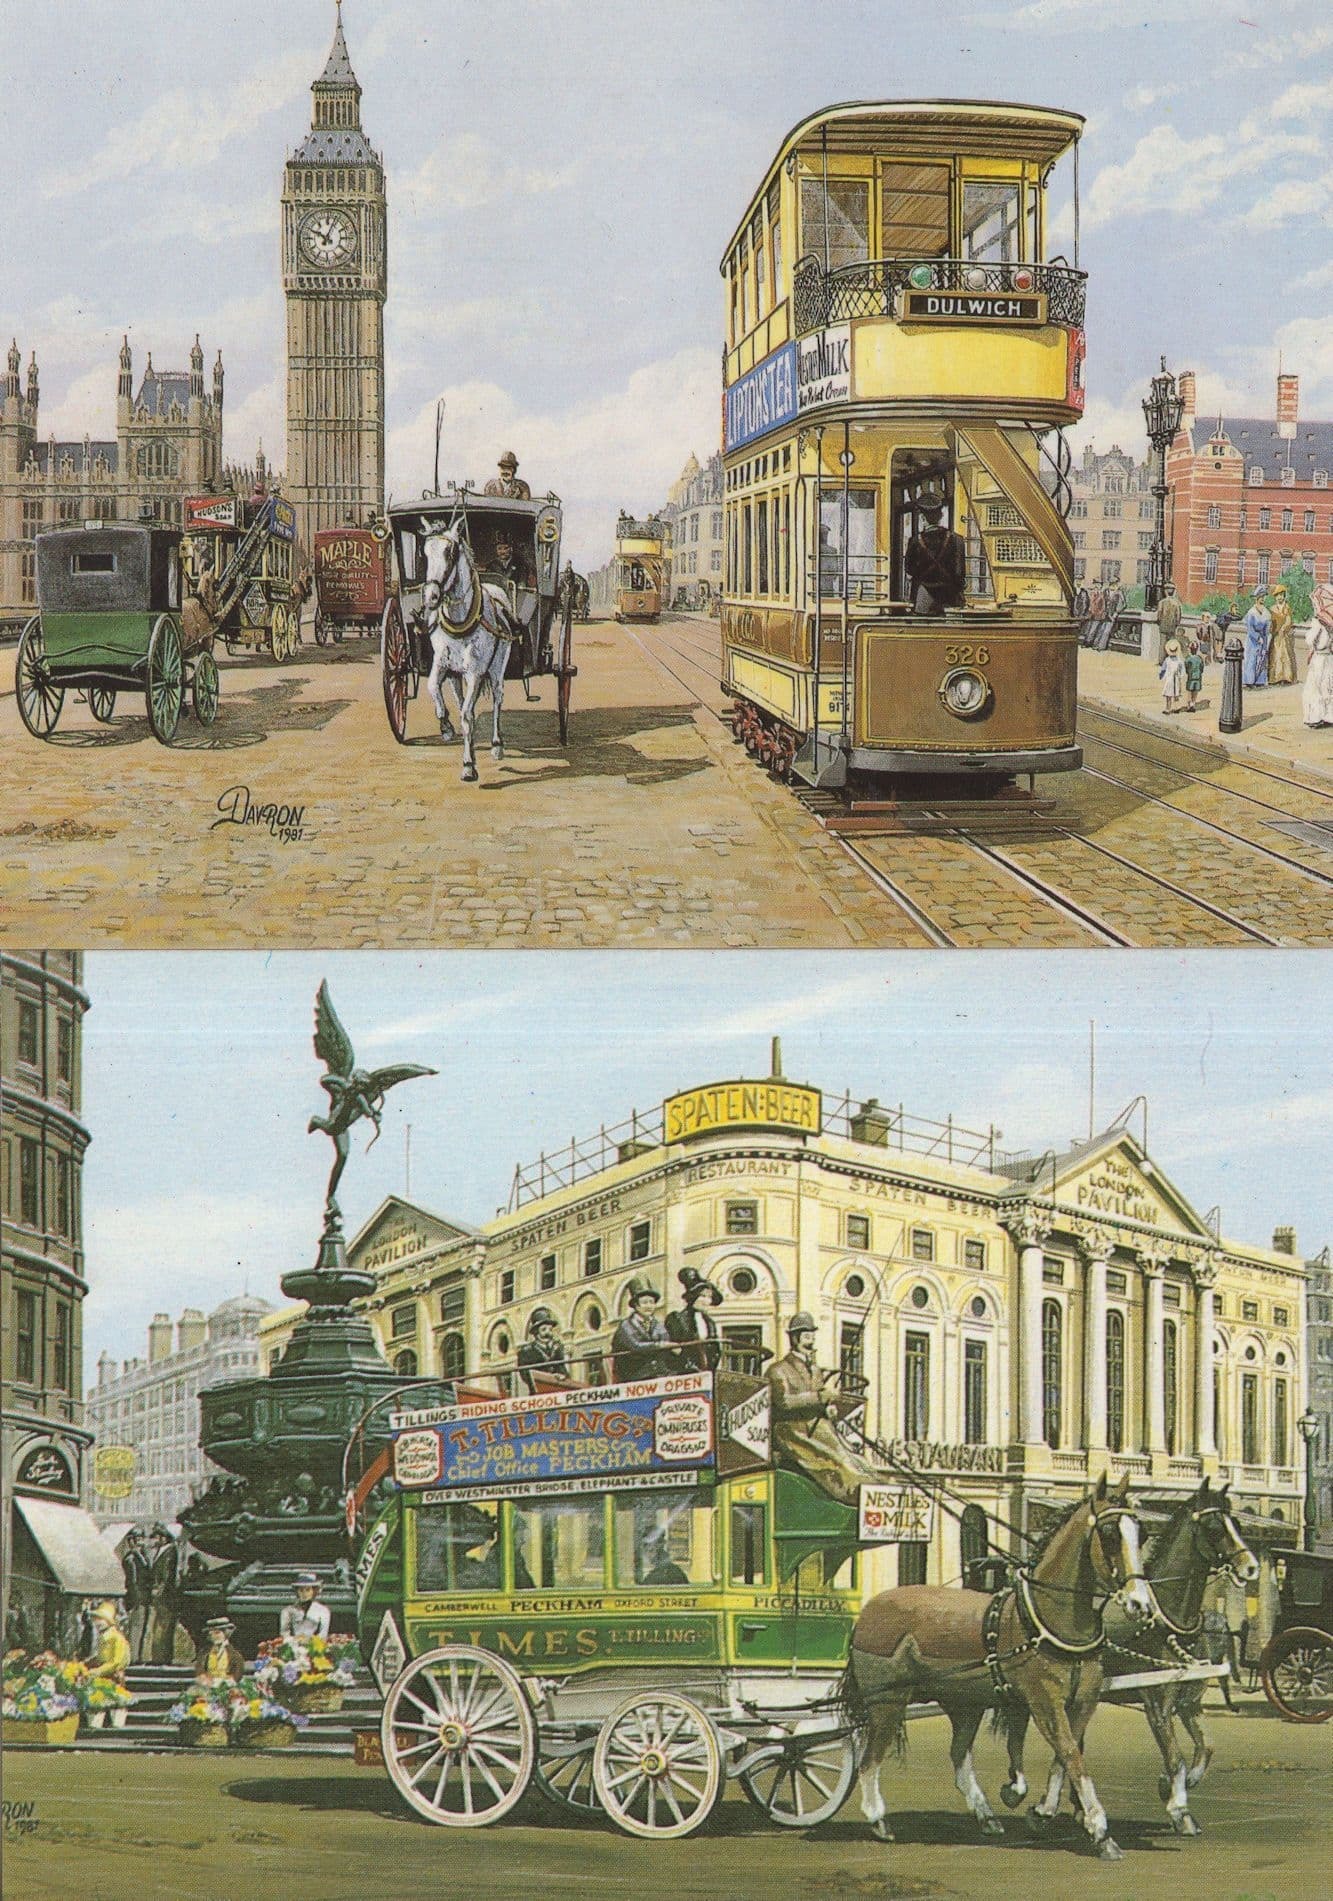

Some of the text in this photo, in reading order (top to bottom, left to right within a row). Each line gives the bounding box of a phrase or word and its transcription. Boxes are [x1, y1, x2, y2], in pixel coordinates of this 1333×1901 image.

[927, 297, 1021, 316] DULWICH
[816, 331, 849, 379] MILK
[768, 351, 793, 422] TEA
[320, 540, 373, 568] MAPLE
[945, 645, 990, 666] 326
[688, 1160, 792, 1182] RESTAURANT
[849, 1177, 991, 1218] SPATEN BEER
[1089, 1173, 1145, 1199] LONDON
[372, 1223, 417, 1250] LONDON
[511, 1200, 621, 1252] SPATEN BEER
[364, 1234, 427, 1270] PAVILION
[394, 1378, 702, 1427] TILLINGS RIDING SCHOOL PECKHAM NOW OPEN
[661, 1403, 705, 1416] PRIVATE
[477, 1409, 631, 1445] TILLING
[483, 1437, 610, 1461] JOB MASTERS
[549, 1448, 652, 1472] PECKHAM
[425, 1490, 452, 1502] OVER
[455, 1484, 530, 1499] WESTMINSTER
[580, 1476, 636, 1490] ELEPHANT
[649, 1473, 694, 1485] CASTLE
[883, 1512, 927, 1528] MILK
[425, 1598, 698, 1613] CAMBERWELL PECKHAM OXFORD STREET
[626, 1628, 696, 1643] TILLING
